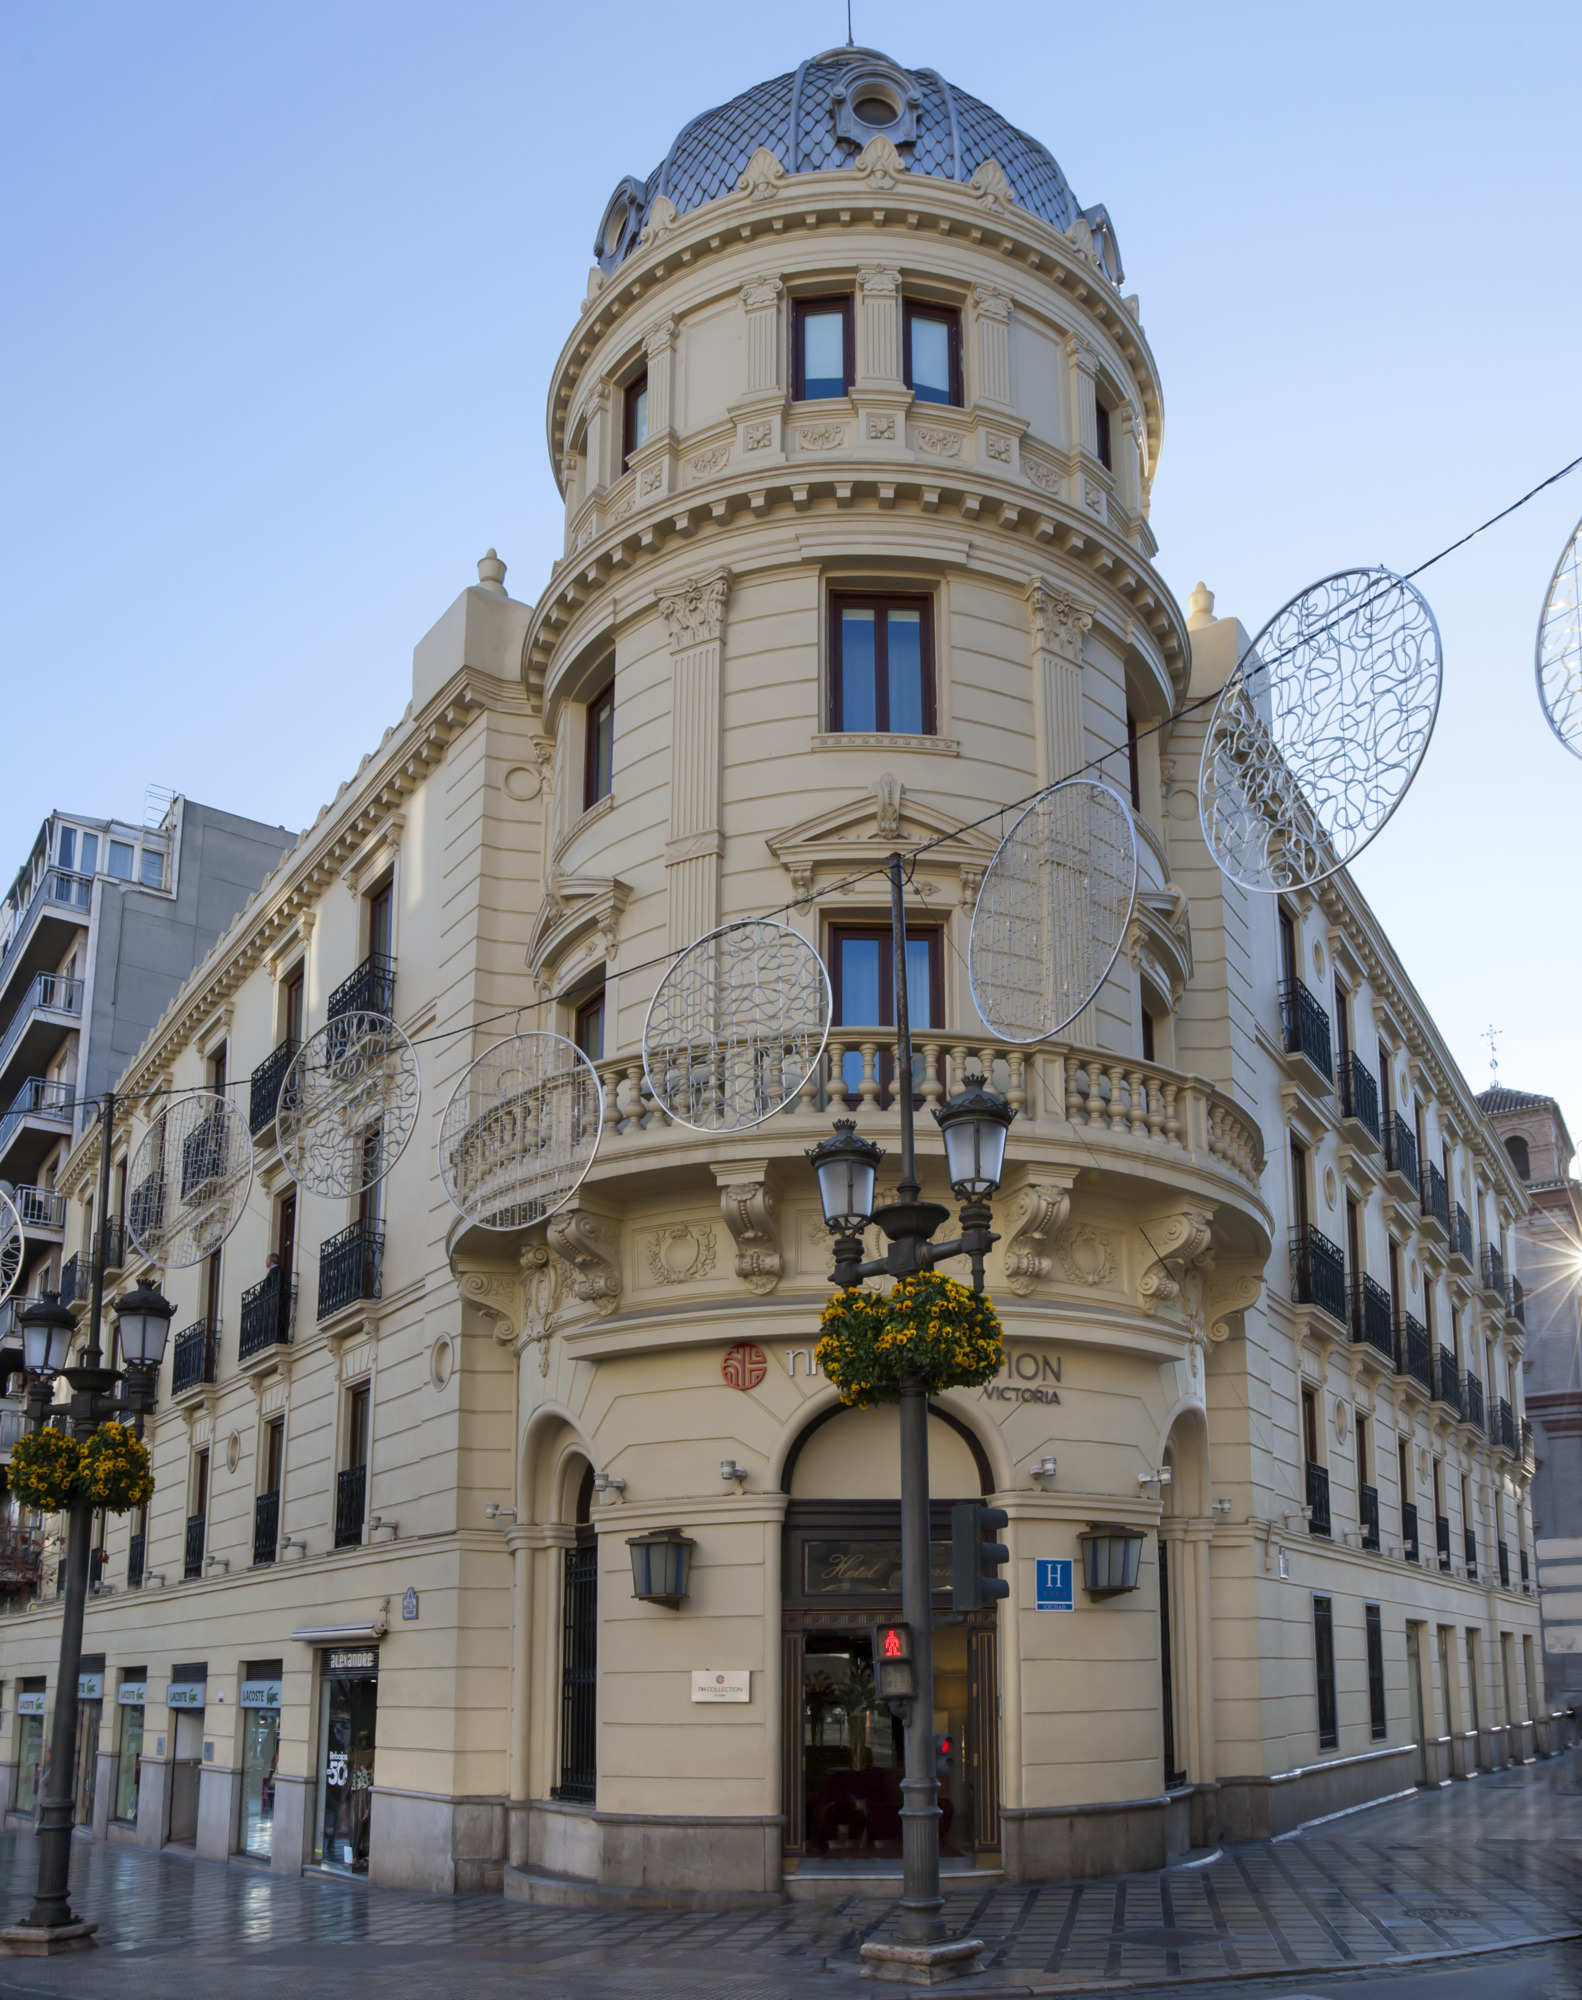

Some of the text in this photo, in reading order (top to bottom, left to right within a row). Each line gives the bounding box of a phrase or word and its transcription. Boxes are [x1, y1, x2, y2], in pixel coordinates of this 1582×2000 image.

[983, 1385, 1061, 1405] VICTORIA
[822, 1554, 888, 1579] Hotel
[1045, 1563, 1063, 1588] H
[170, 1691, 188, 1702] LACOSTE
[243, 1690, 265, 1702] LACOSTE
